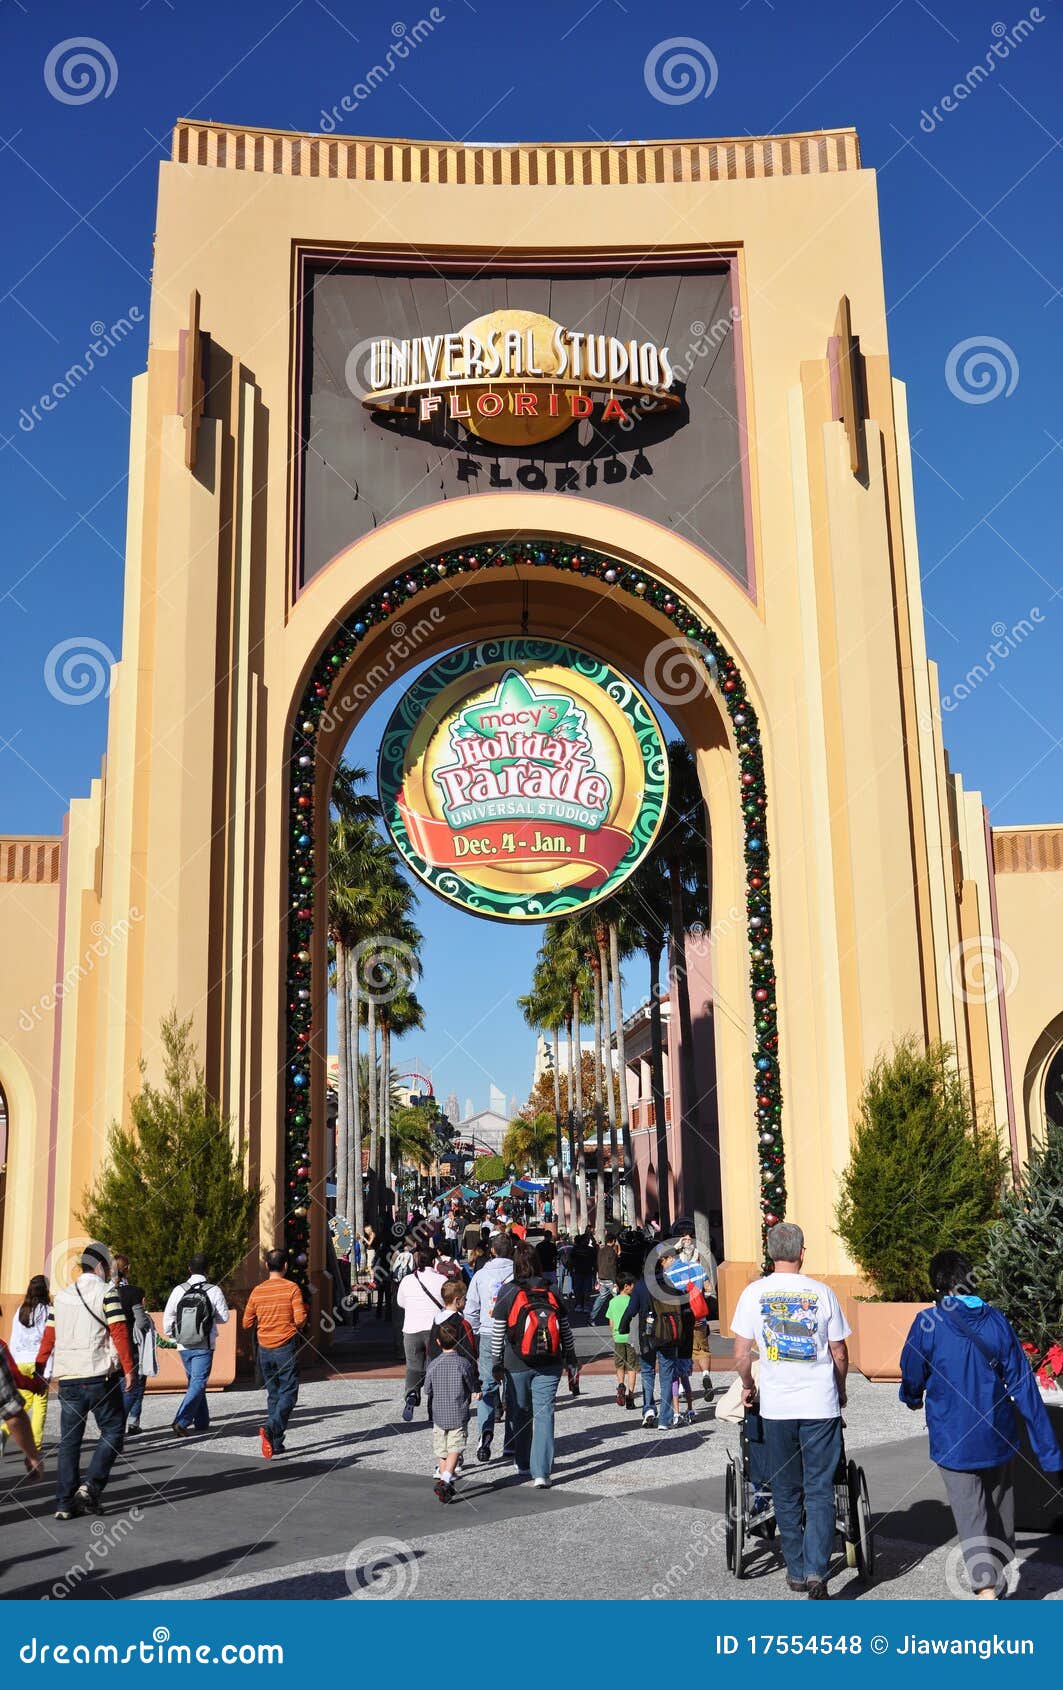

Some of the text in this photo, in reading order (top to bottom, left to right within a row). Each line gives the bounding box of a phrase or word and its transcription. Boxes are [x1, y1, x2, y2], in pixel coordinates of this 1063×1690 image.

[370, 326, 674, 390] UNIVERSAL STUDIOS
[420, 393, 628, 421] FLORIDA
[479, 704, 558, 730] macy's
[455, 731, 586, 768] Holiday
[437, 759, 607, 811] Parade
[451, 802, 599, 827] UNIVERSAL STUDIOS
[453, 834, 497, 857] Dec.
[502, 833, 516, 852] 4
[530, 832, 572, 853] Jan.
[579, 834, 586, 853] 1
